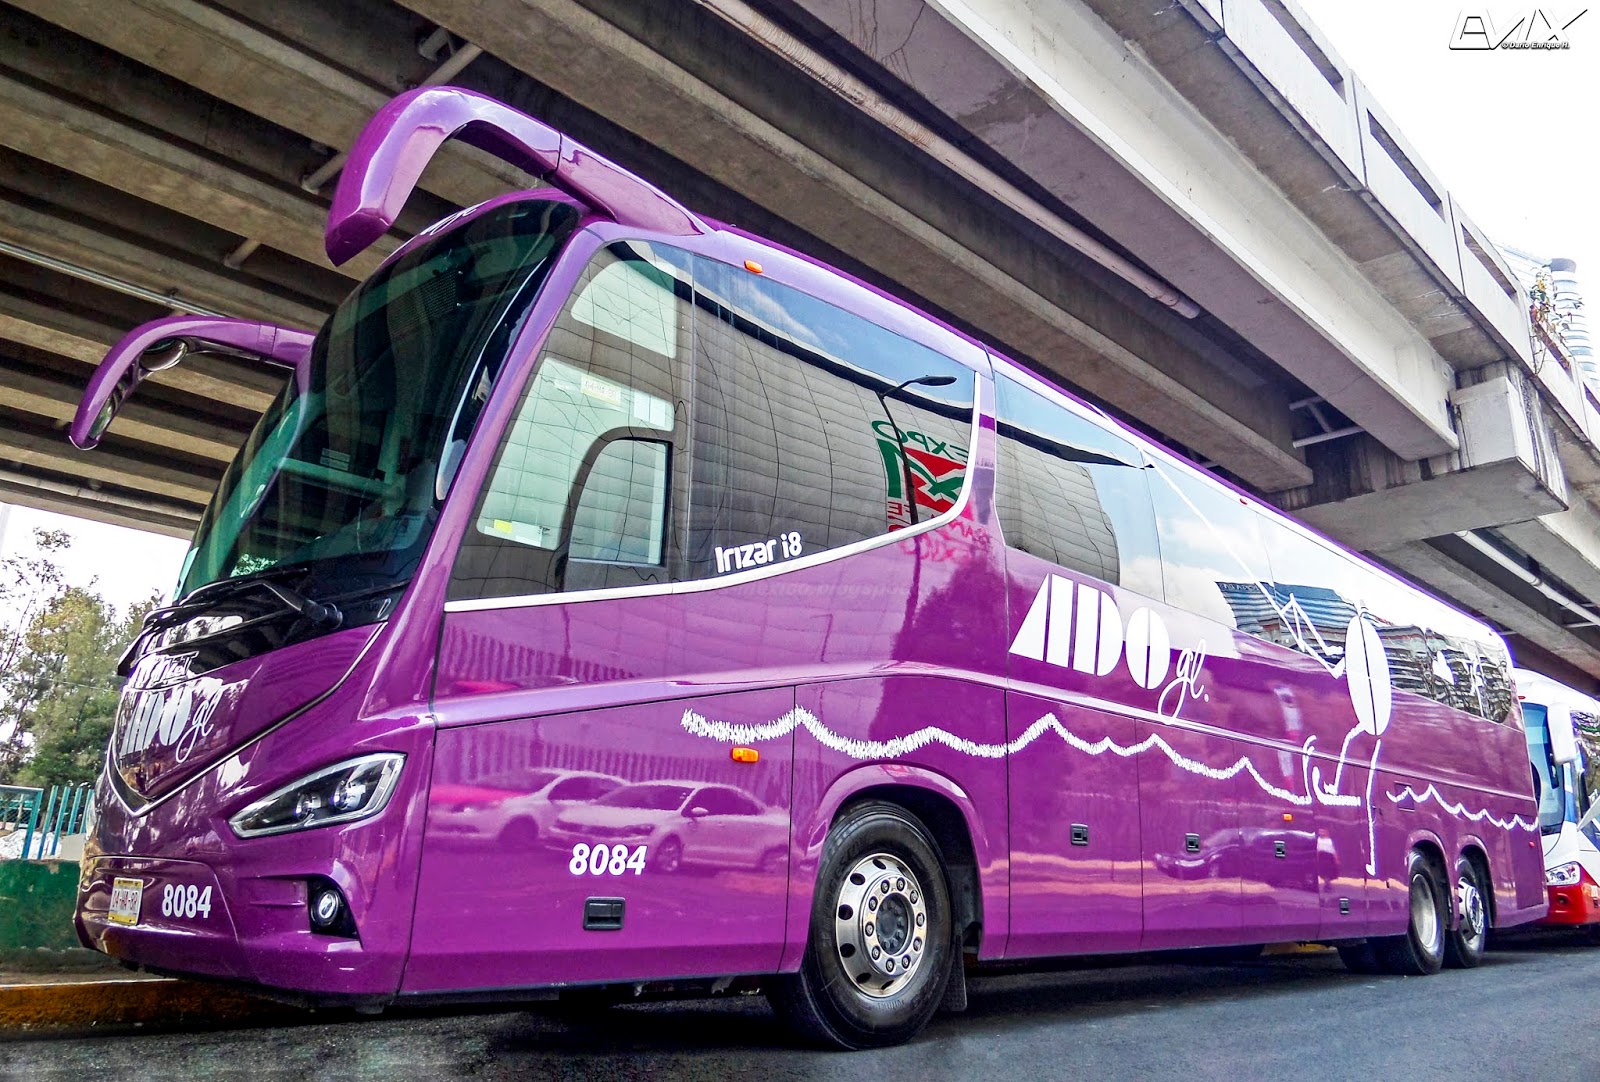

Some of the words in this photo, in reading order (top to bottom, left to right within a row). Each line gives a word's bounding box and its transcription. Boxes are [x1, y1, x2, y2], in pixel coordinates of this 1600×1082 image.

[715, 539, 777, 573] Irizar
[780, 531, 802, 559] i8
[1008, 572, 1171, 690] ADO
[568, 842, 648, 876] 8084
[161, 883, 212, 918] 8084
